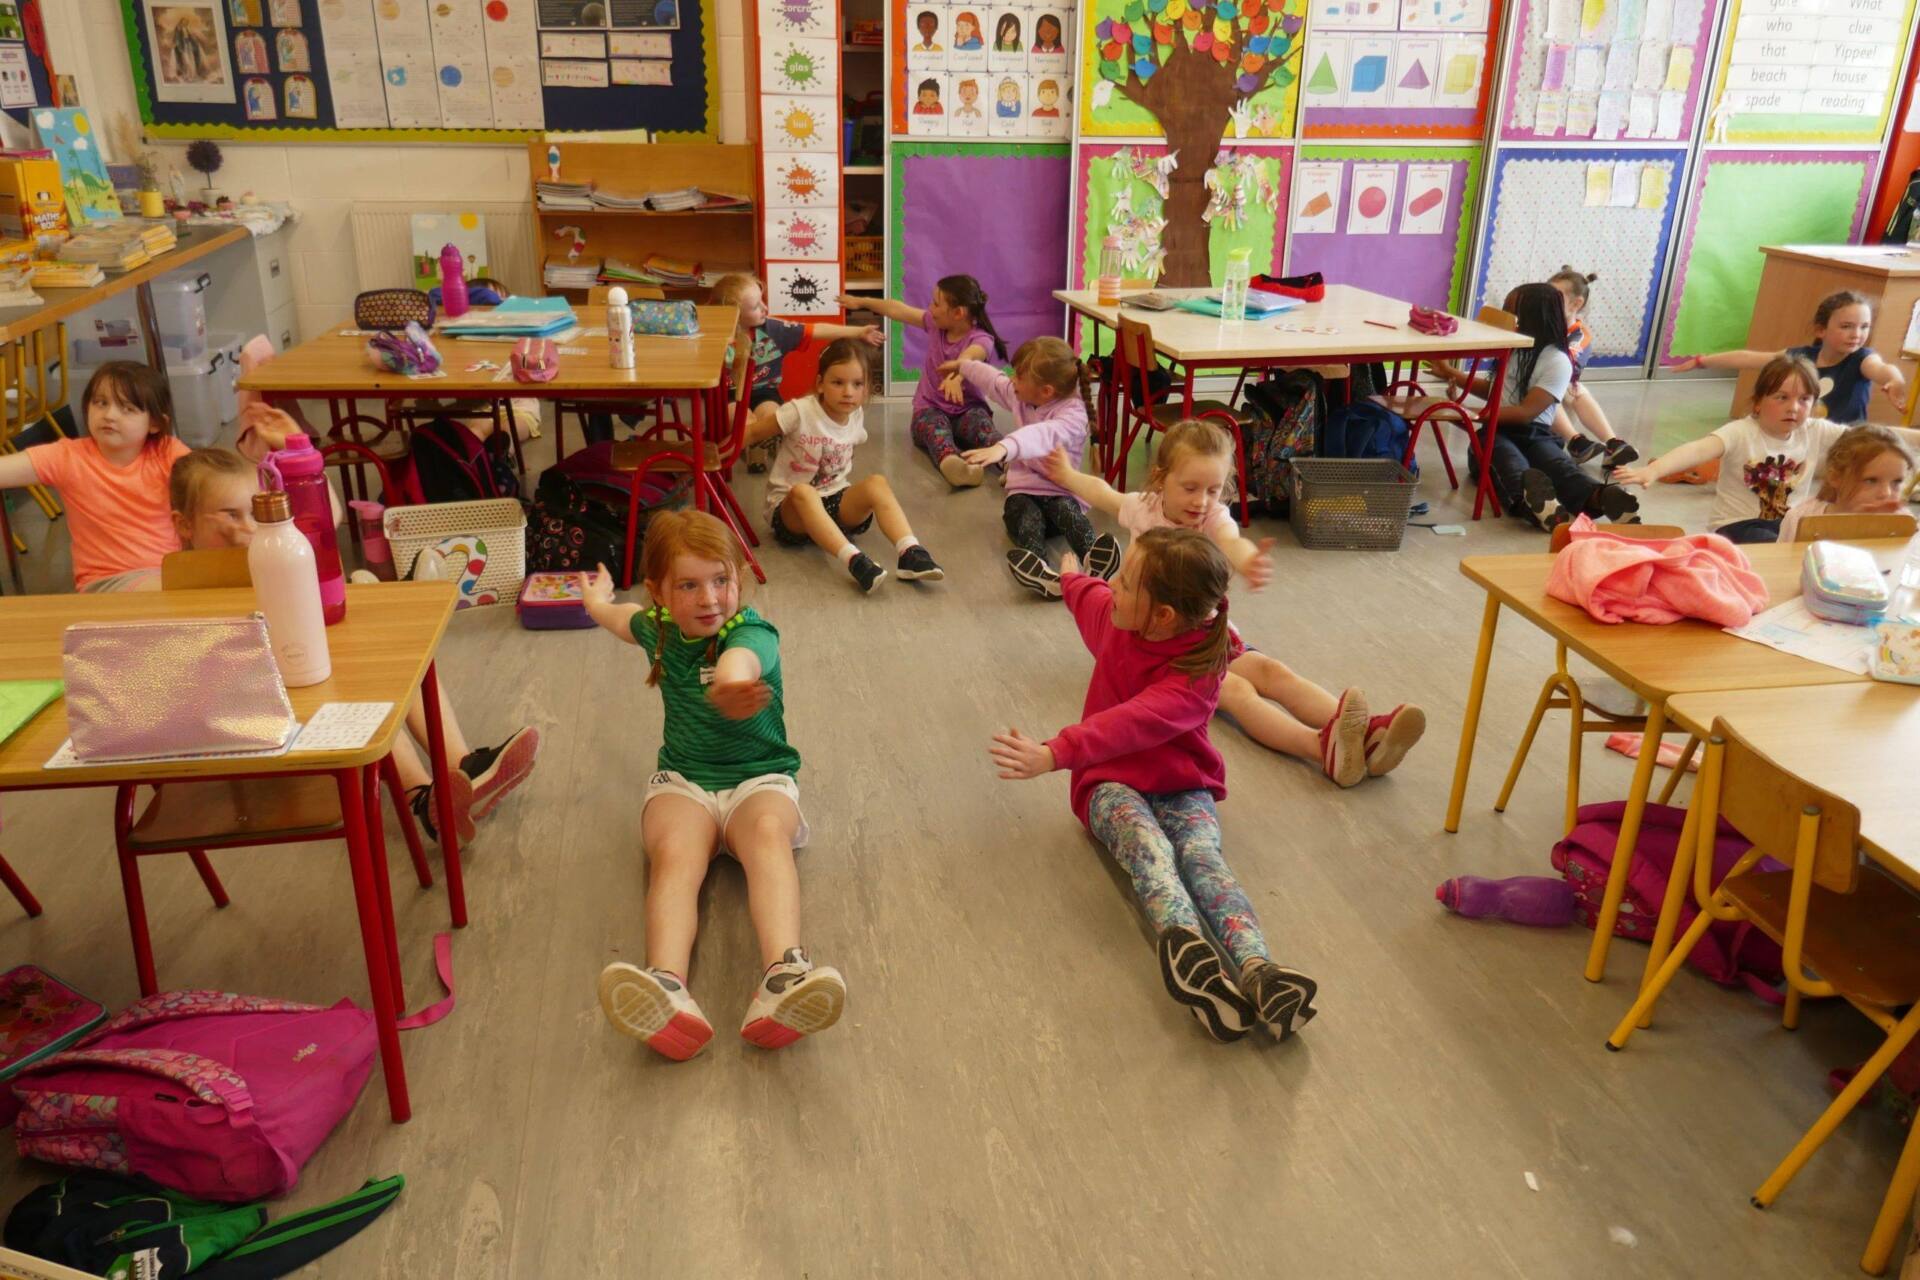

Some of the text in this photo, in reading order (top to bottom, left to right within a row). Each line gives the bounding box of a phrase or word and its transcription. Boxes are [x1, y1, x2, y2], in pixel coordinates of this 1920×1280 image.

[1766, 16, 1793, 32] who
[1848, 19, 1873, 34] clue
[1761, 42, 1787, 58] that
[1751, 67, 1788, 82] beach
[1832, 69, 1868, 84] house
[1745, 93, 1782, 109] spade
[1820, 94, 1865, 113] reading
[799, 432, 833, 448] Super
